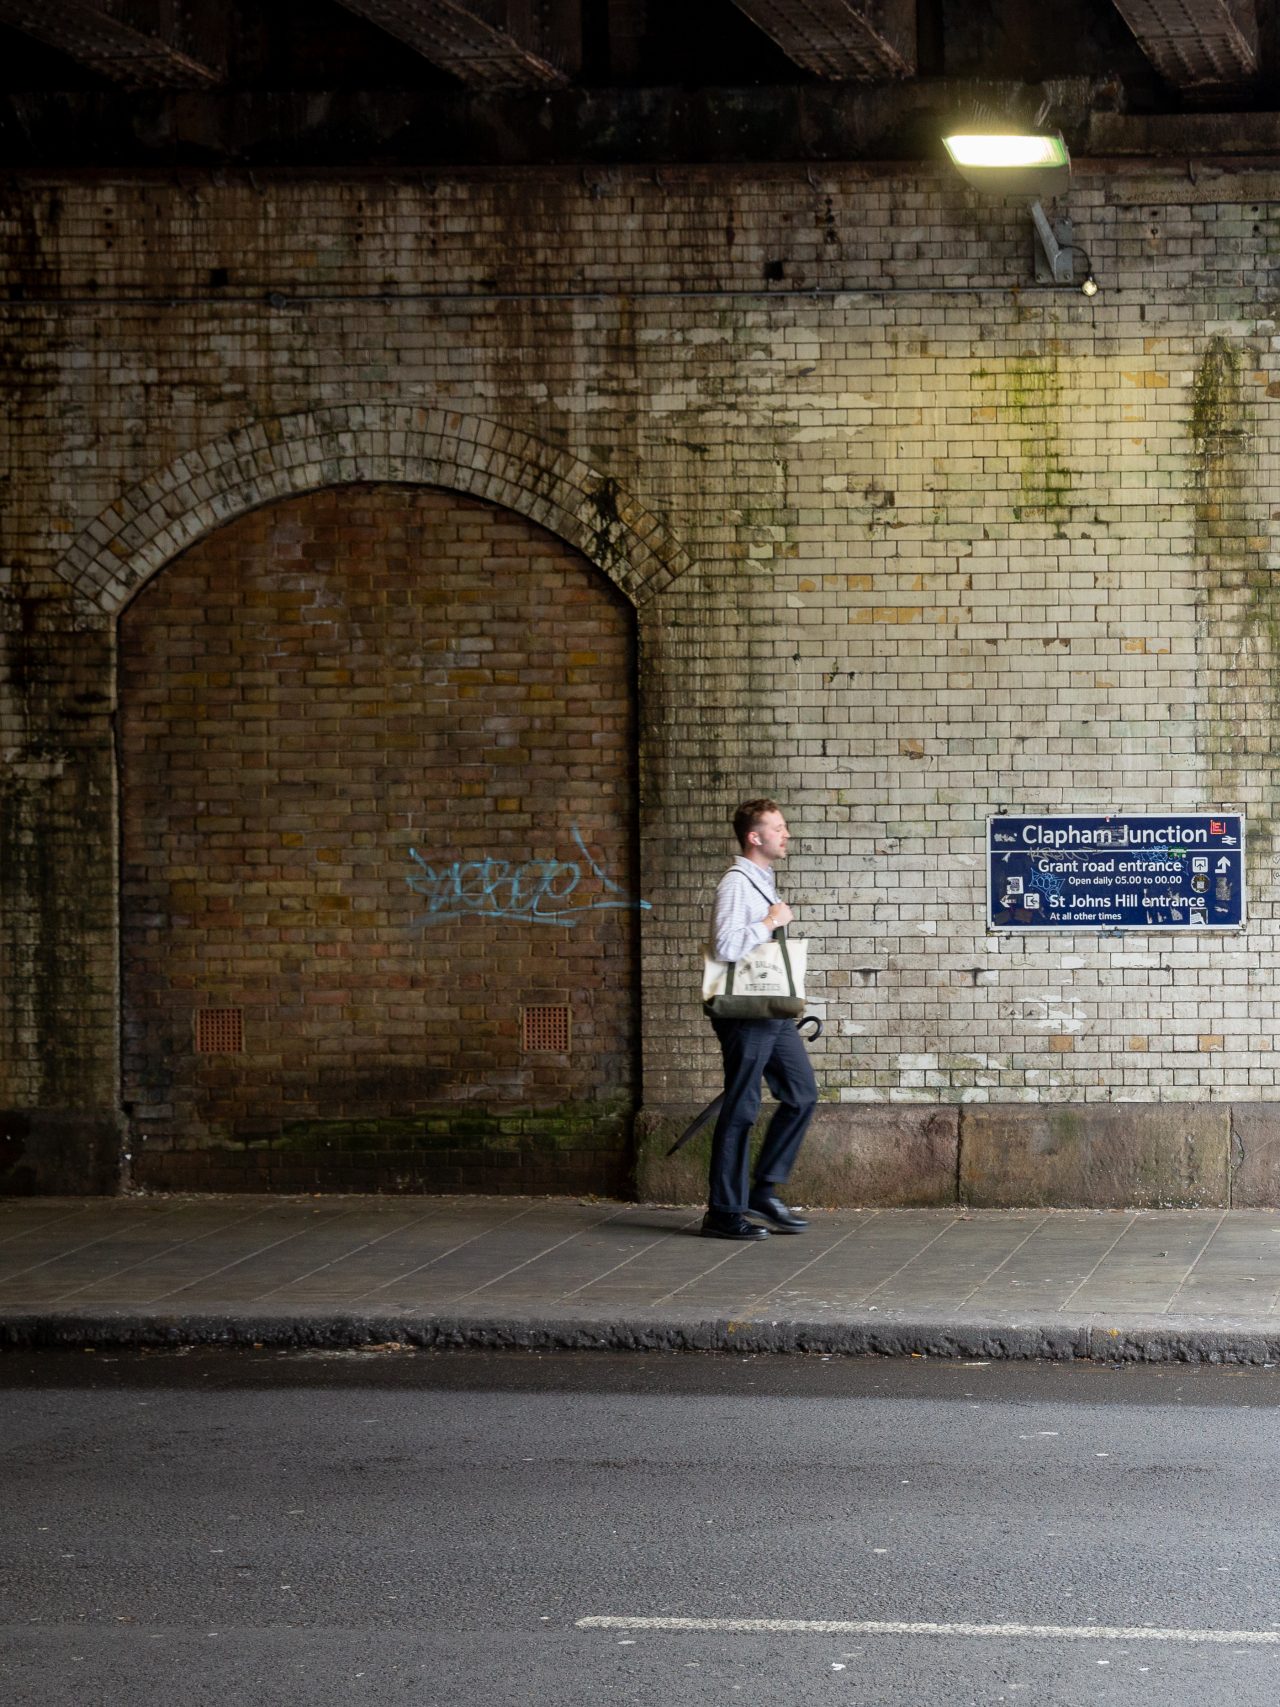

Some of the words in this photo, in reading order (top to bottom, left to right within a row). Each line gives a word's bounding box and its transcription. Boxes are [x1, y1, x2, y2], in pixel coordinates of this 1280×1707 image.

[1022, 825, 1112, 848] Clapham
[1118, 824, 1208, 843] Junction
[1038, 859, 1079, 873] Grant
[1082, 859, 1115, 872] road
[1118, 861, 1182, 872] entrance
[1068, 876, 1091, 886] Open
[1095, 876, 1113, 886] daily
[1114, 875, 1142, 884] 05.00
[1143, 876, 1153, 884] to
[1154, 875, 1182, 884] 00.00
[1049, 894, 1066, 908] St
[1069, 894, 1111, 908] Johns
[1114, 894, 1138, 907] Hill
[1141, 895, 1205, 907] entrance
[1049, 912, 1061, 920] At
[1061, 911, 1072, 920] all
[1077, 912, 1097, 920] other
[1098, 911, 1122, 920] times
